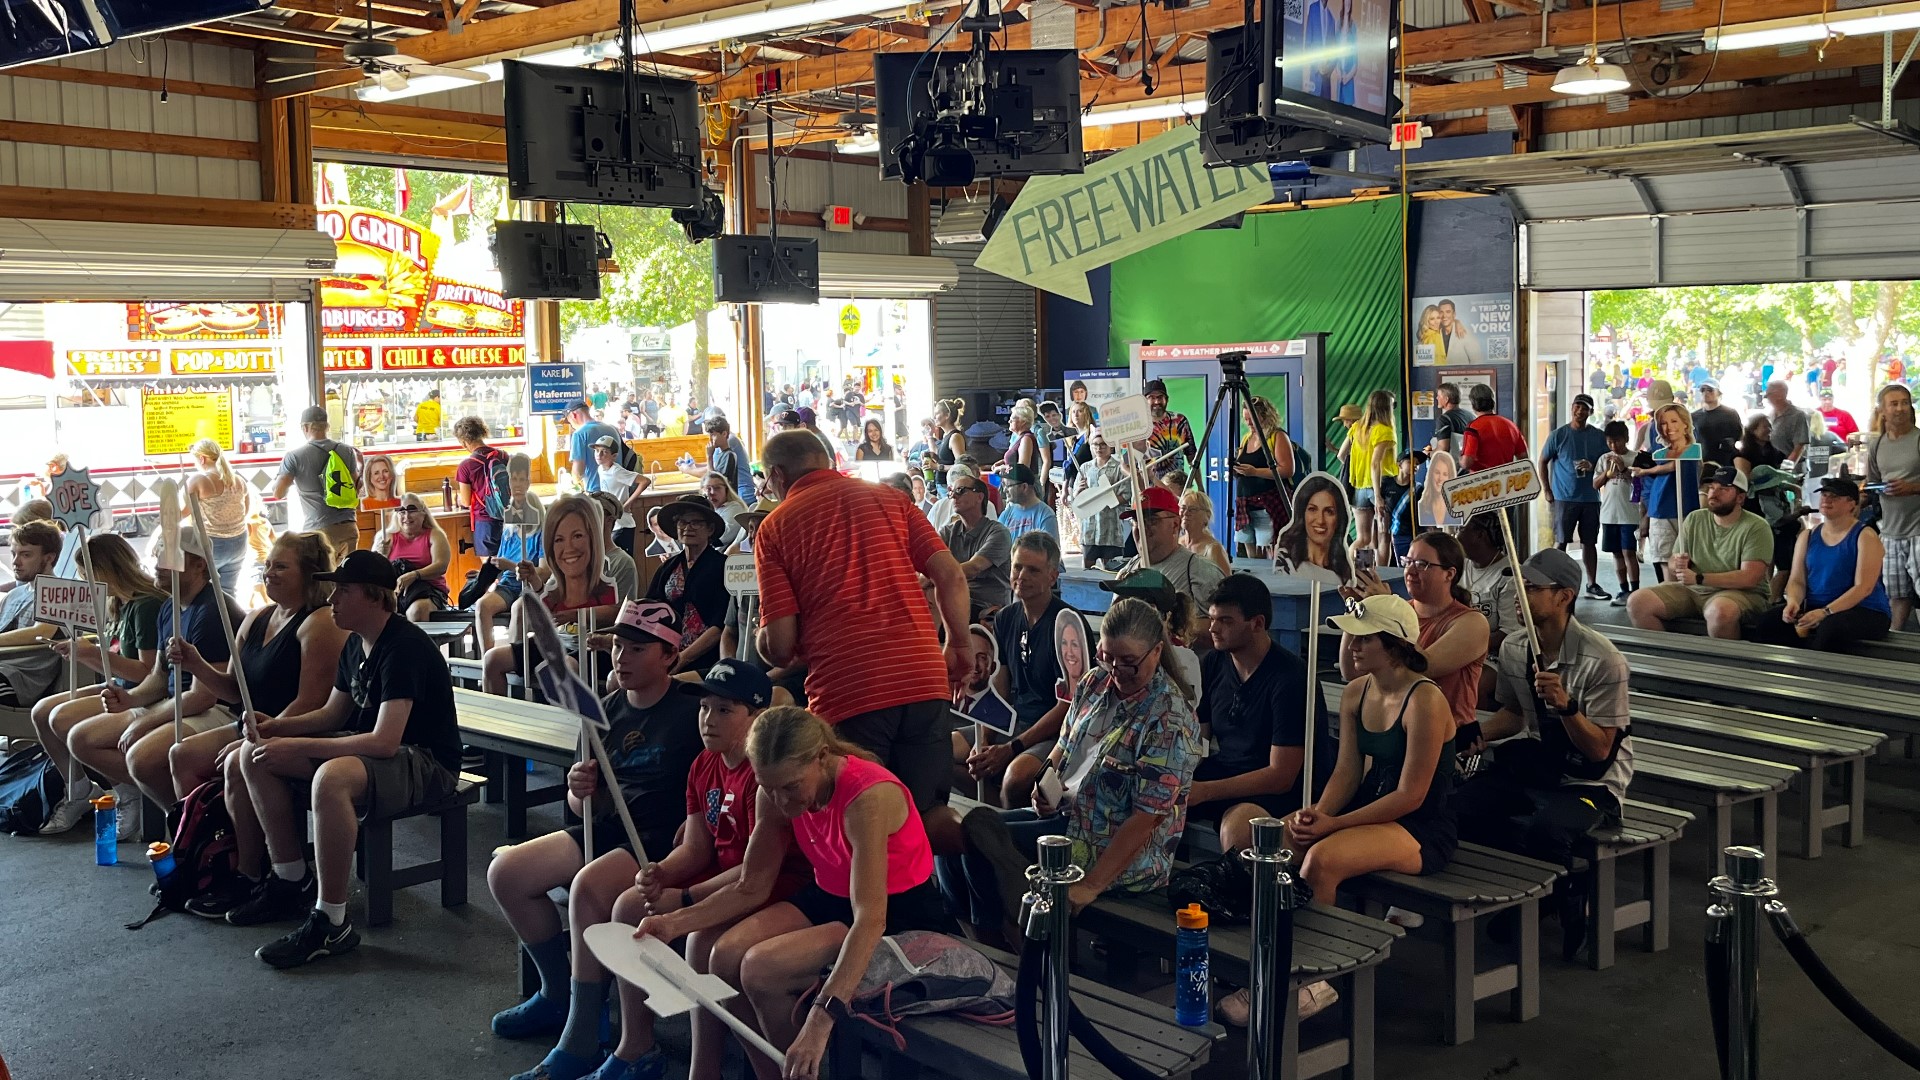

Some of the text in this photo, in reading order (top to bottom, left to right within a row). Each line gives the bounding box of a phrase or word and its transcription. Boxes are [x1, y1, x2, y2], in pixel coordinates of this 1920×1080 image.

[351, 213, 427, 272] GRILL
[436, 283, 516, 314] BRATWURST
[1480, 311, 1511, 322] NEW
[1471, 322, 1511, 334] YORK!
[1182, 347, 1221, 356] WEATHER
[1247, 345, 1269, 354] WALL
[323, 349, 366, 367] ATER
[386, 350, 427, 367] CHILI
[433, 350, 446, 365] &
[452, 348, 503, 365] CHEESE
[86, 362, 145, 374] FRIES
[541, 369, 561, 378] KARE
[540, 390, 582, 398] Haferman
[1109, 406, 1121, 416] THE
[1105, 425, 1126, 438] STATE
[1451, 470, 1532, 508] PRONTO PUP
[56, 480, 92, 514] OPE
[728, 571, 753, 582] CROP
[41, 586, 76, 604] EVERY
[40, 605, 97, 625] sunrise
